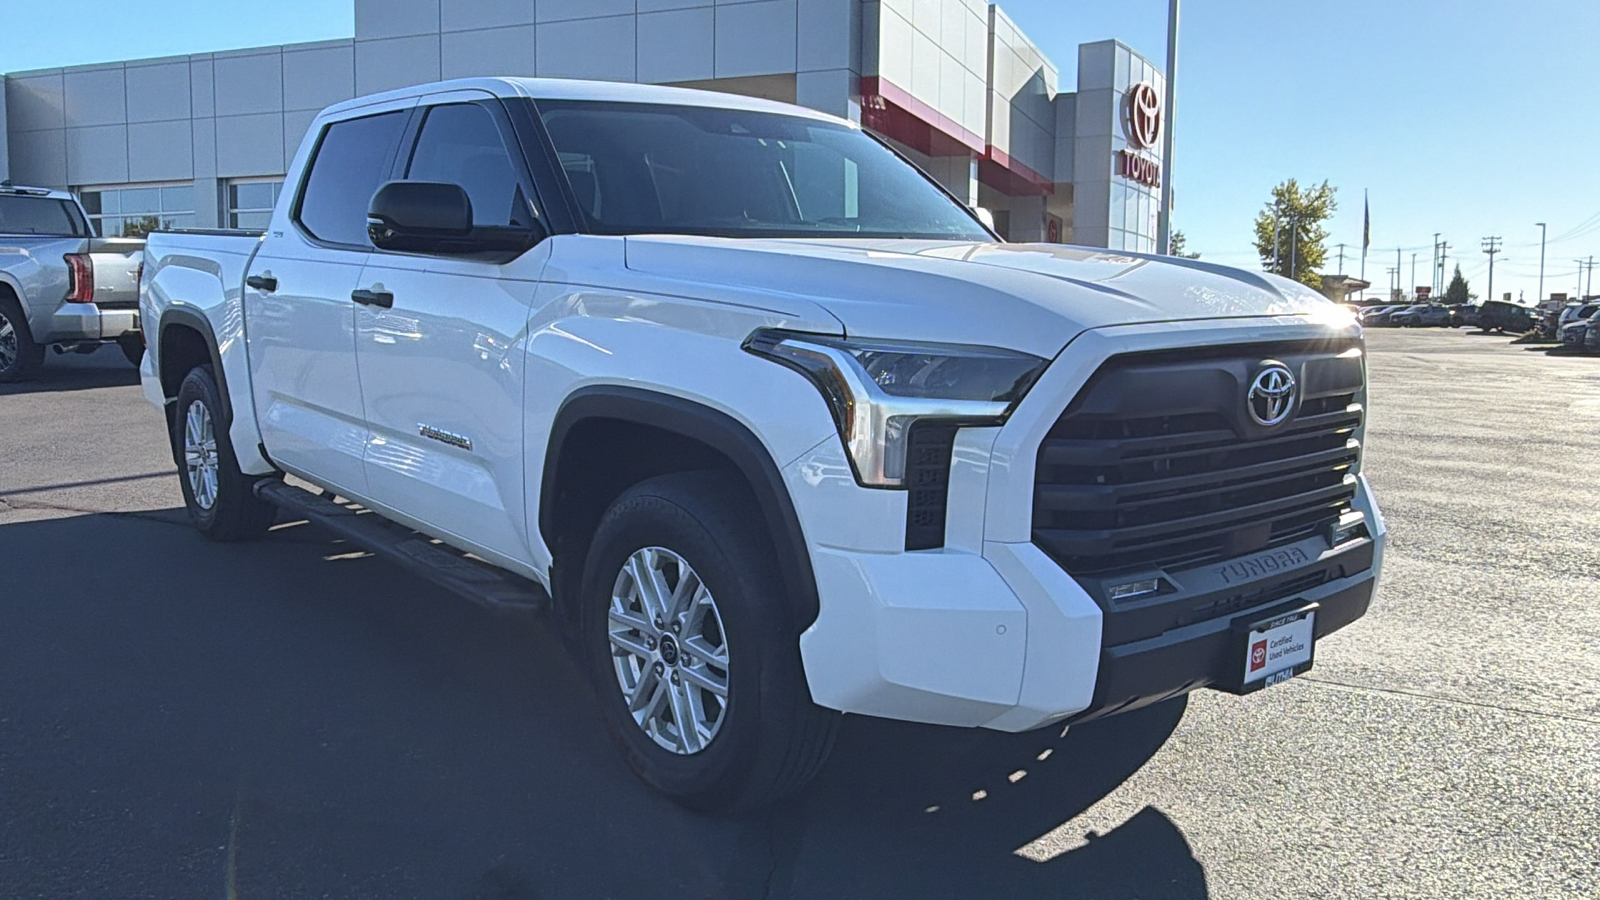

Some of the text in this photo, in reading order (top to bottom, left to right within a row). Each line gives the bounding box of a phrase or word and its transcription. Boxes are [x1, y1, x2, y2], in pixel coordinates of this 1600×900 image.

[1215, 547, 1309, 584] TUNDRA
[1270, 635, 1293, 649] Certified
[1269, 643, 1305, 661] Used Vehicles
